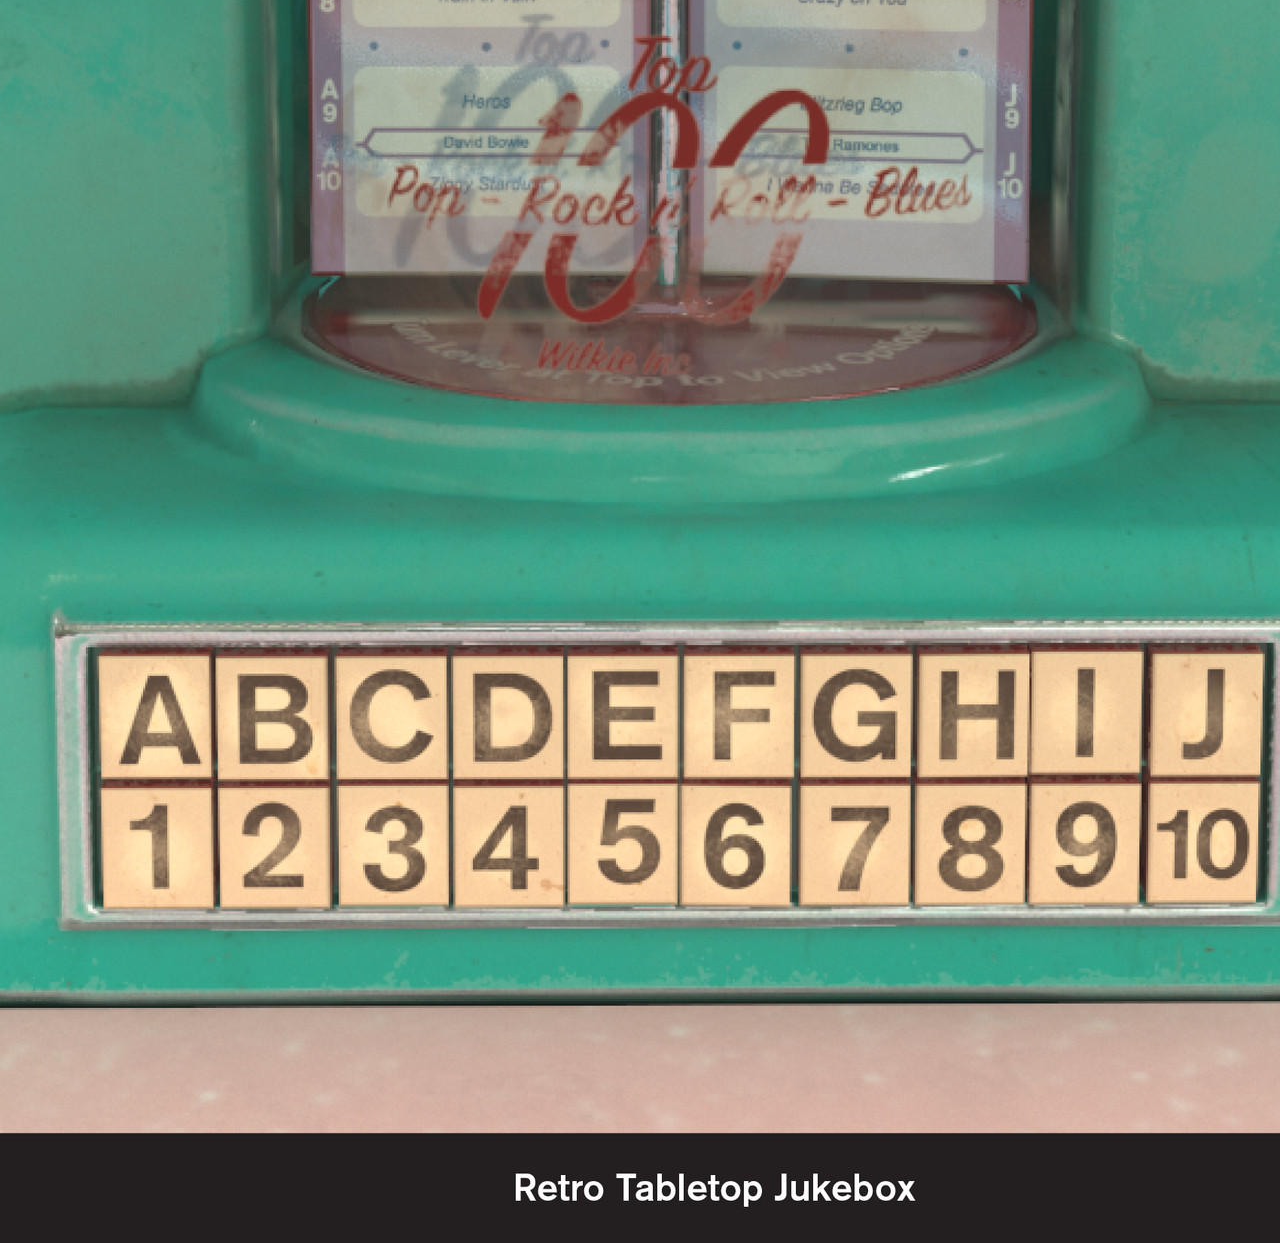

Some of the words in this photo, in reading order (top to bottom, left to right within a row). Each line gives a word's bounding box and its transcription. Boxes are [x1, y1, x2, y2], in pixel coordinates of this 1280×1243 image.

[628, 34, 718, 100] Top
[800, 94, 866, 115] itzrieg
[869, 95, 903, 116] Bop
[443, 136, 483, 149] David
[487, 135, 529, 150] Bowie
[832, 139, 901, 154] Ramones
[388, 165, 466, 229] Pop
[519, 174, 641, 227] Rock
[709, 174, 817, 226] Roll
[864, 165, 972, 219] Blues
[479, 176, 548, 191] Stardu
[840, 179, 862, 195] Be
[476, 89, 831, 327] 100
[538, 337, 637, 375] Wilkie
[120, 675, 202, 765] A
[237, 674, 314, 765] B
[349, 669, 434, 763] C
[472, 674, 554, 763] D
[593, 670, 663, 761] E
[714, 670, 775, 760] F
[812, 668, 897, 763] G
[939, 670, 1016, 760] H
[1182, 668, 1226, 760] J
[129, 804, 170, 888] 1
[242, 803, 304, 888] 2
[364, 806, 426, 892] 3
[472, 806, 540, 890] 4
[597, 798, 661, 885] 5
[704, 803, 765, 890] 6
[830, 806, 890, 892] 7
[938, 805, 1004, 892] 8
[1055, 801, 1117, 888] 9
[1156, 809, 1250, 881] 10
